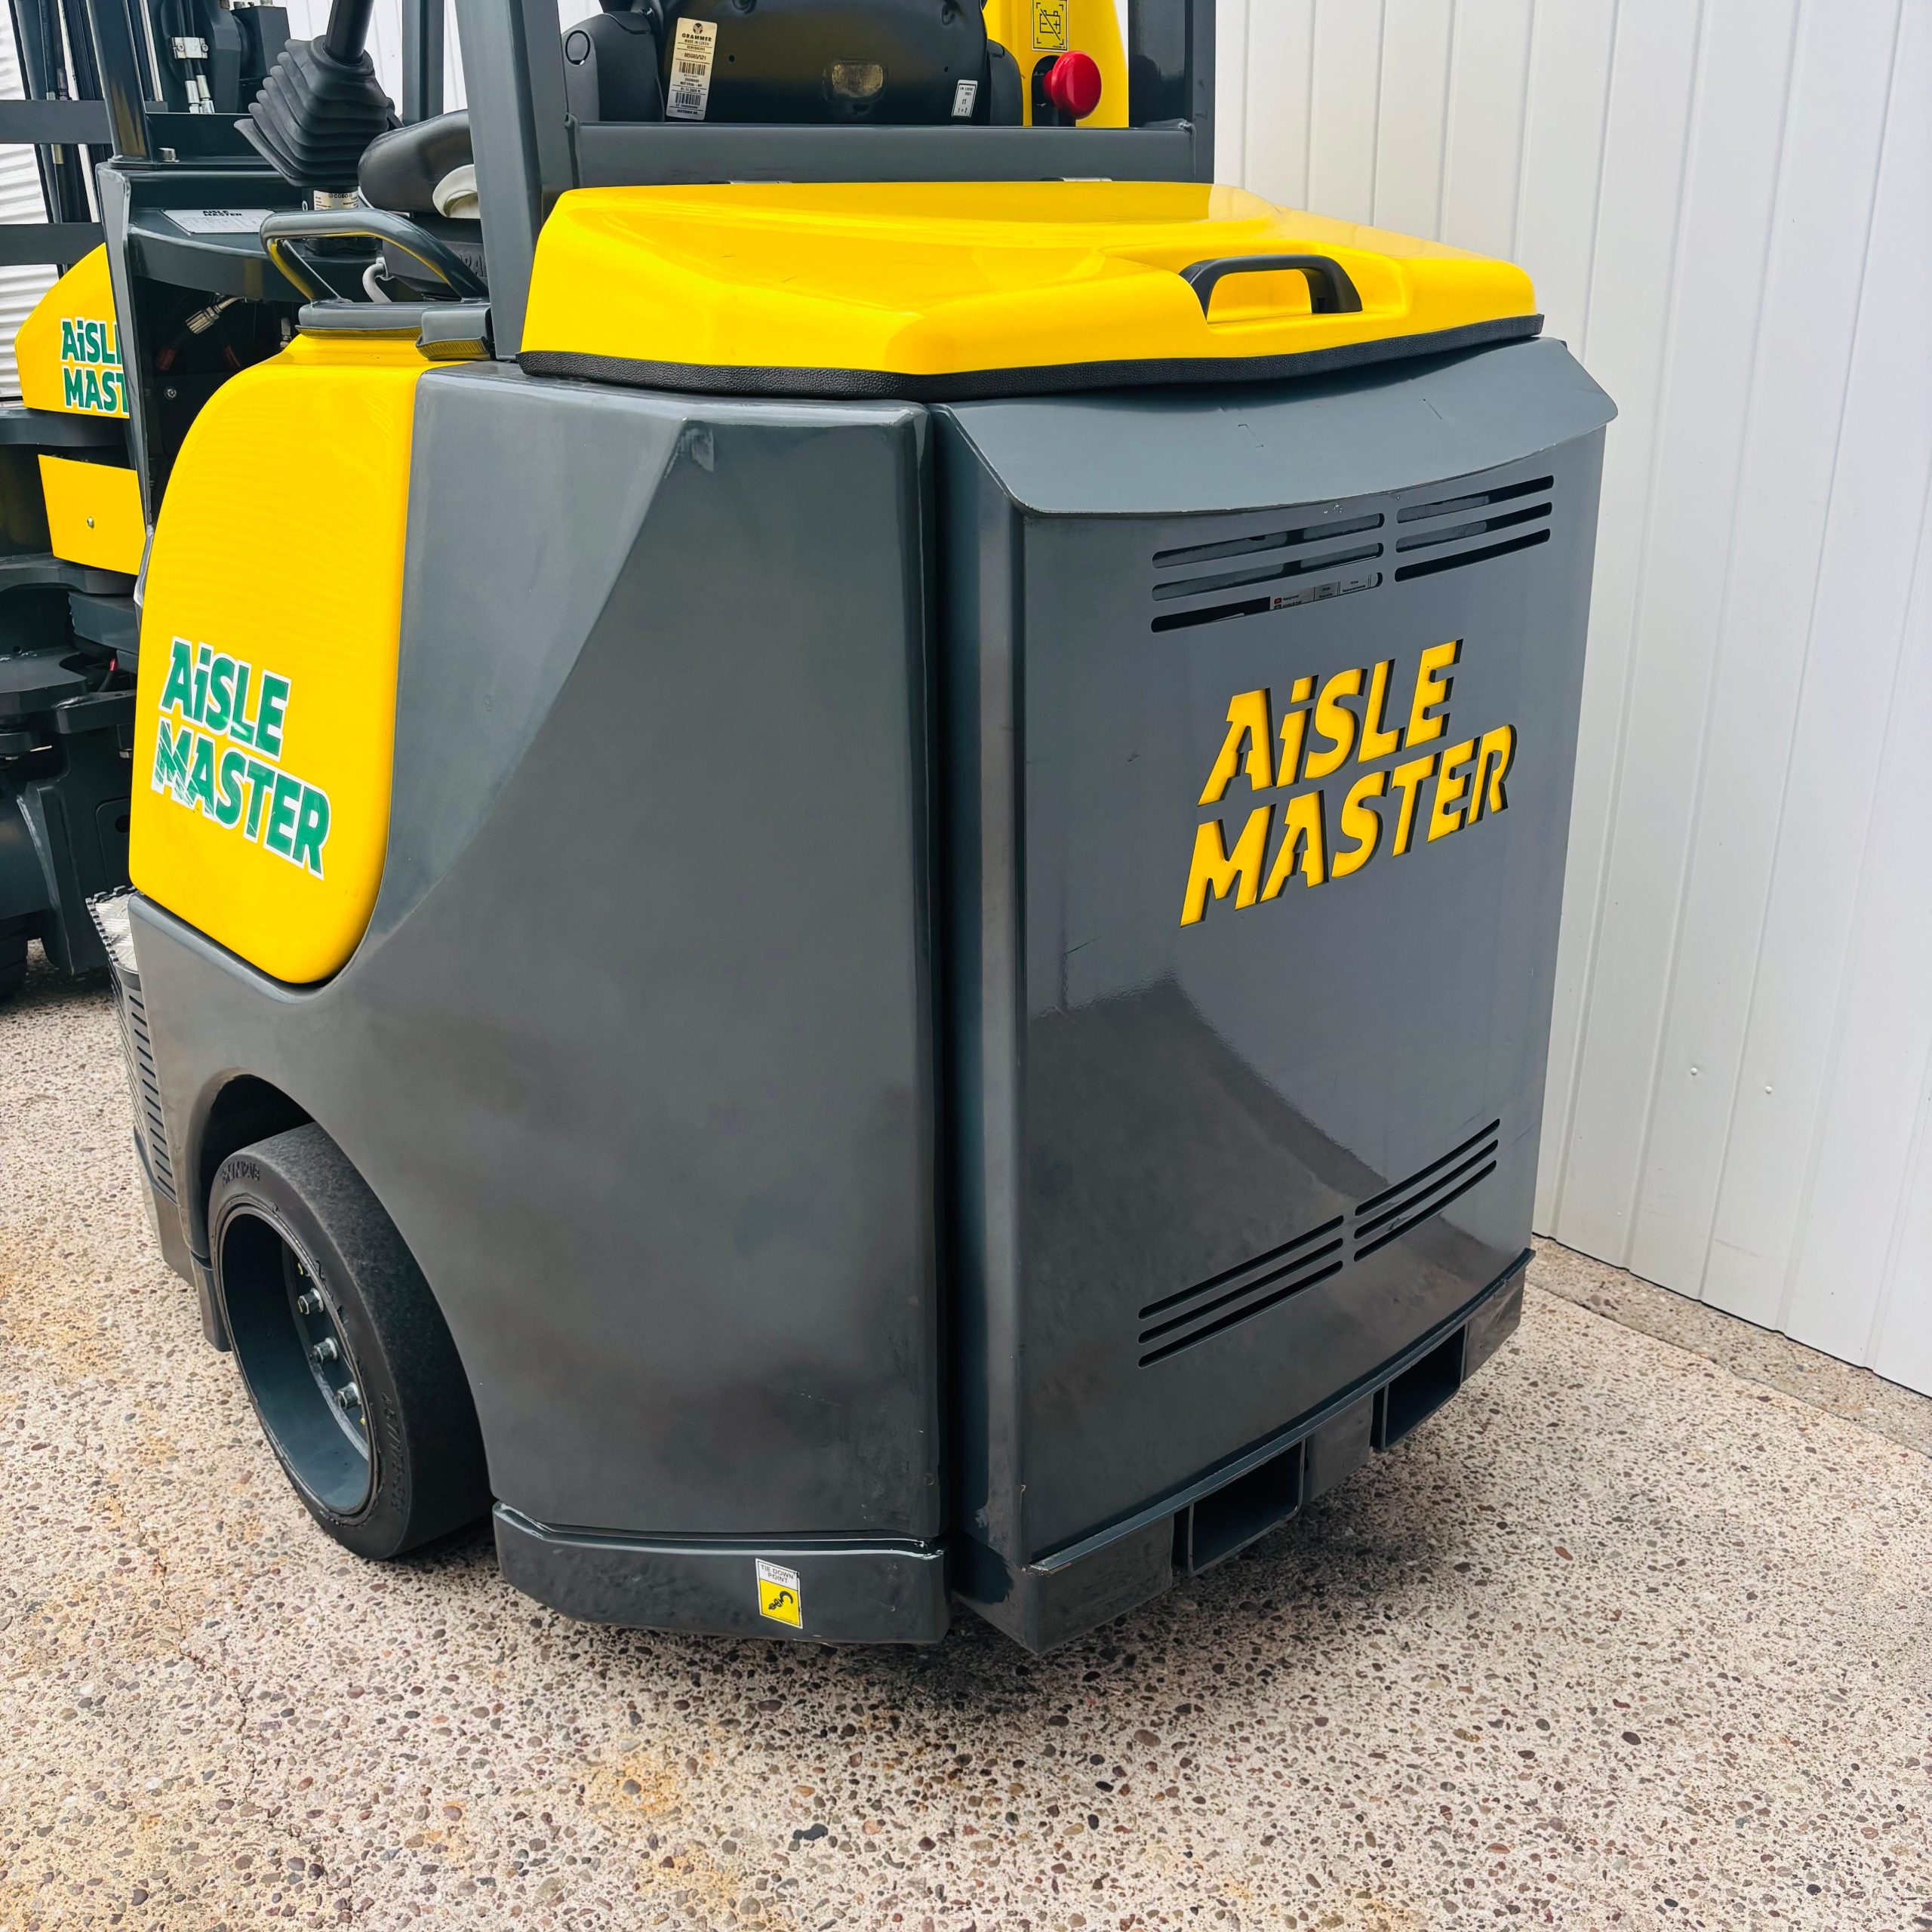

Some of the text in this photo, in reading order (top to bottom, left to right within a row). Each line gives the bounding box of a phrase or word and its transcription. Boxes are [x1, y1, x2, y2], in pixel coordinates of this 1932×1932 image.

[151, 715, 331, 880] MASTER
[1180, 724, 1517, 928] MASTER
[761, 1564, 794, 1580] TIE DOWN
[768, 1573, 789, 1583] POINT
